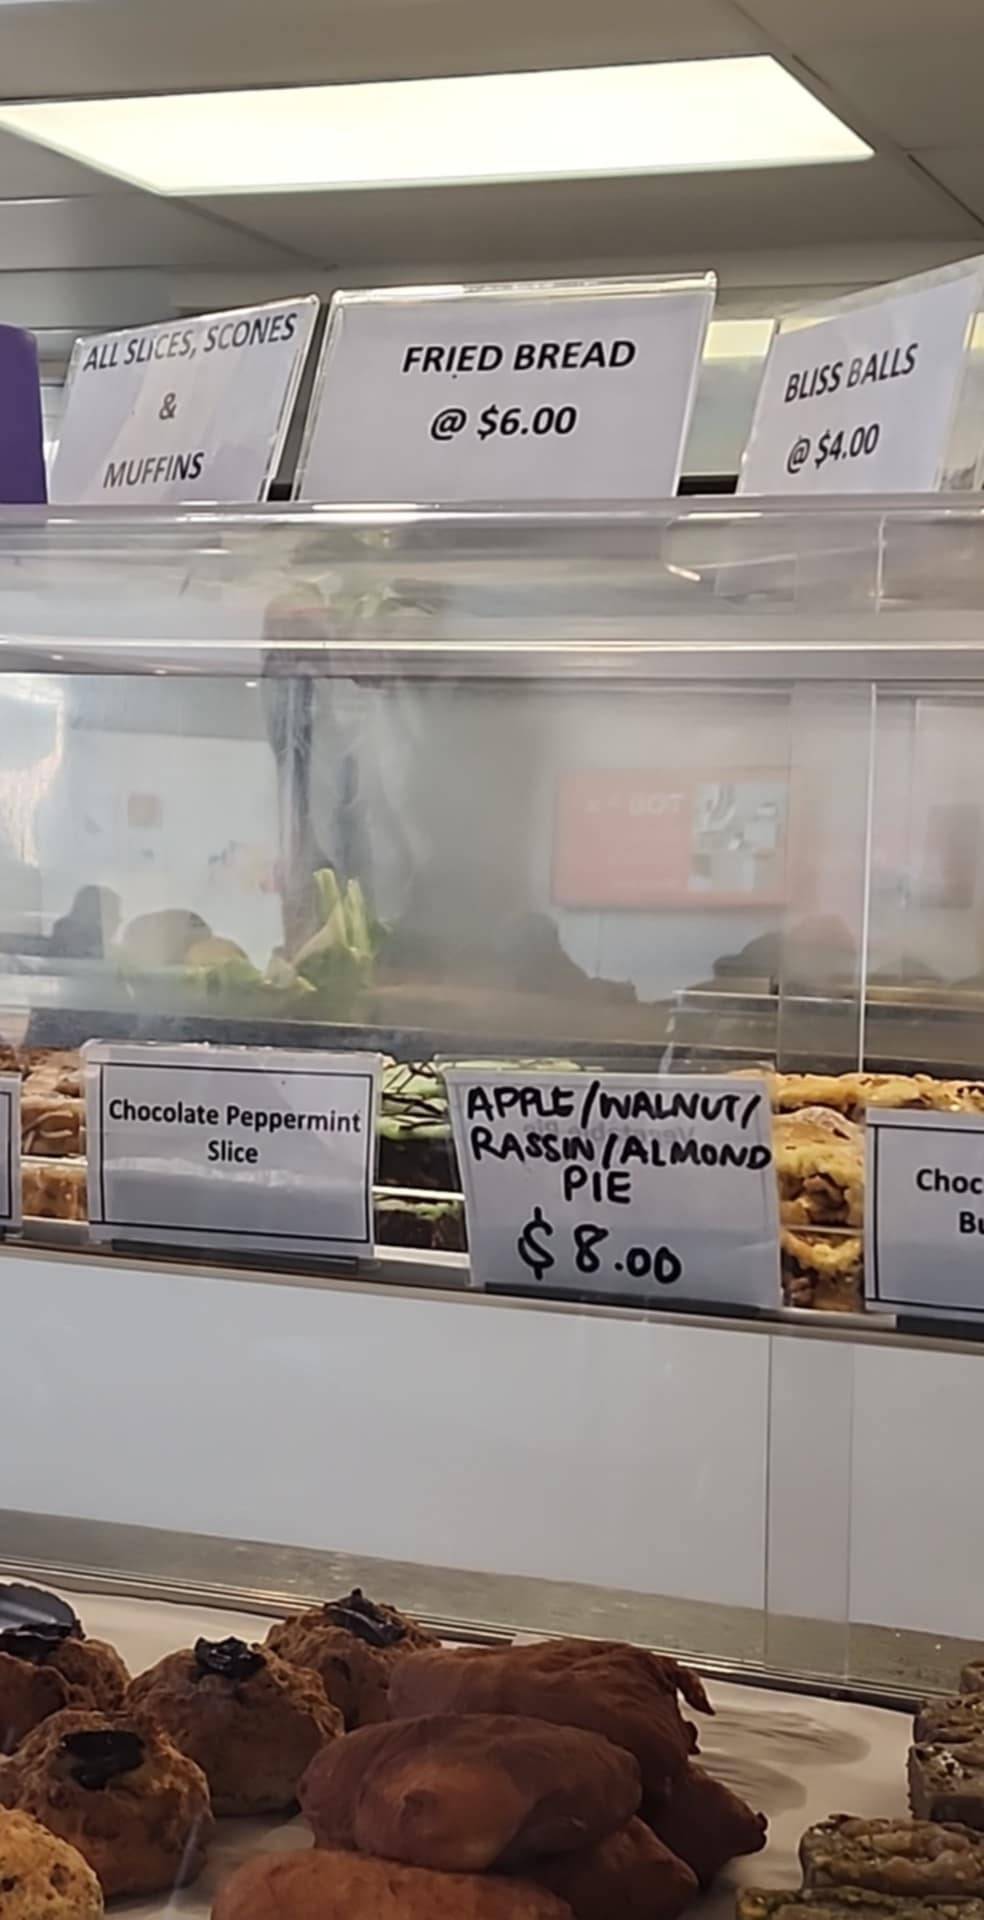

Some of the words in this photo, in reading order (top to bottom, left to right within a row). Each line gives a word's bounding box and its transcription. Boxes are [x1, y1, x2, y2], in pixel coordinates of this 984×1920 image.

[82, 340, 118, 371] ALL
[123, 330, 196, 364] SLICES,
[203, 312, 298, 352] SCONES
[402, 345, 503, 373] FRIED
[513, 341, 637, 371] BREAD
[784, 361, 842, 403] BLISS
[846, 343, 919, 389] BALLS
[159, 393, 177, 420] &
[430, 408, 467, 440] @
[477, 405, 577, 440] $6.00
[787, 438, 810, 474] @
[815, 424, 880, 469] $4.00
[103, 452, 205, 488] MUFFINS
[109, 1099, 219, 1126] Chocolate
[226, 1105, 361, 1133] Peppermint
[207, 1140, 259, 1163] Slice
[563, 1164, 631, 1203] PIE
